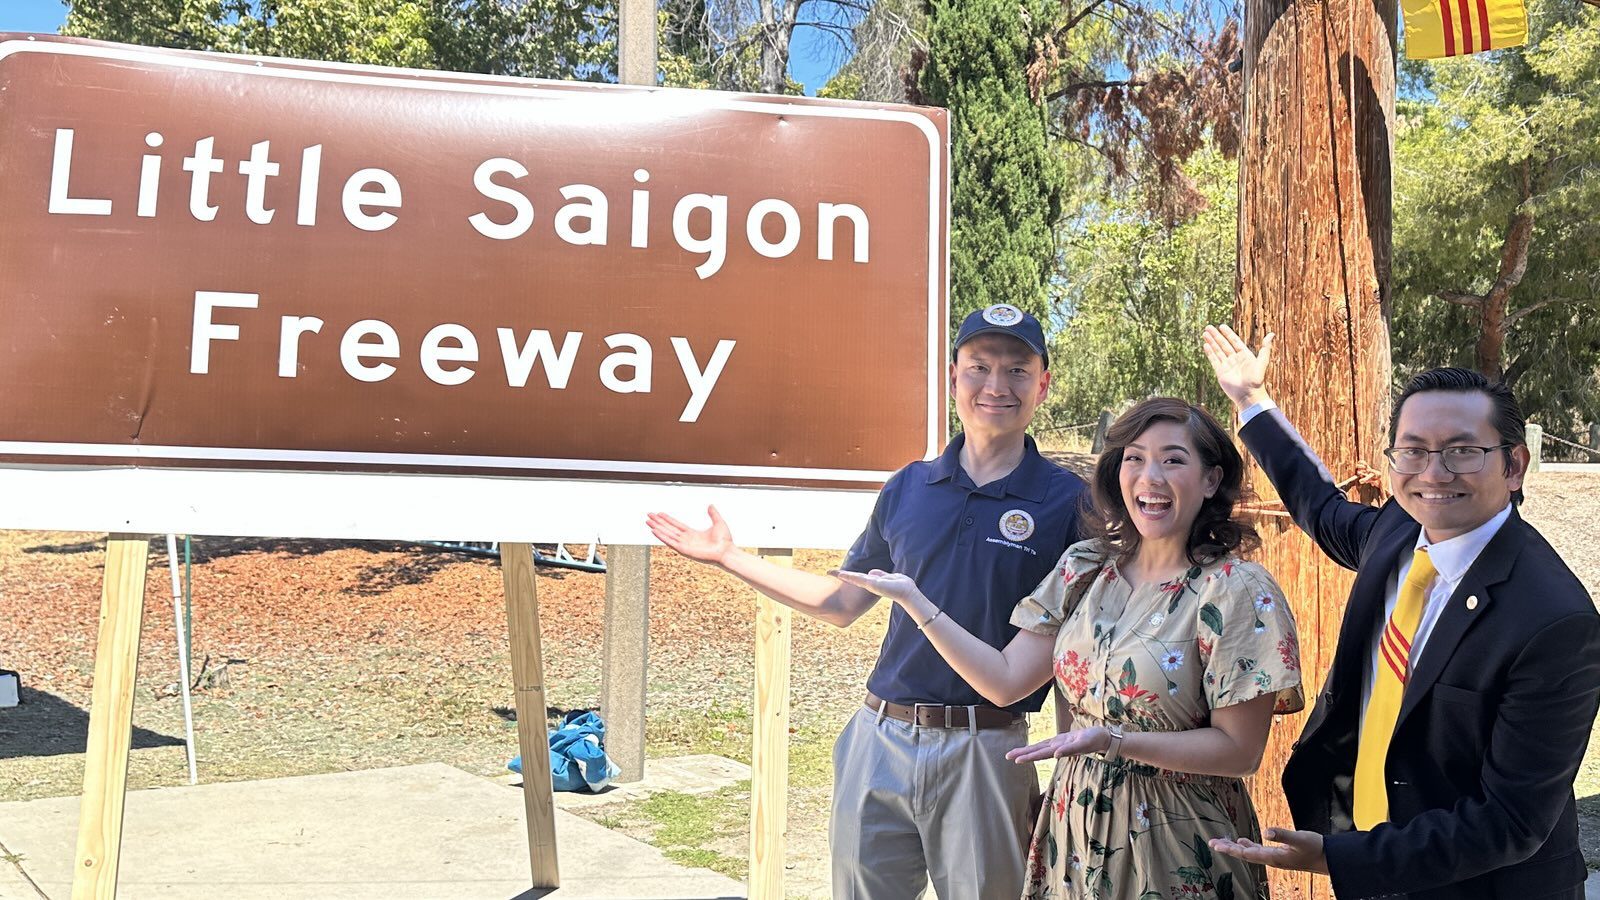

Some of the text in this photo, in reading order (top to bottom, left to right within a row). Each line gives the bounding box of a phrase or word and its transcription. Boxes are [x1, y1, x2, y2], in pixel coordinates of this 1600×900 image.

[48, 129, 869, 279] Little Saigon
[191, 291, 736, 422] Freeway
[985, 537, 1023, 550] Assemblyman
[1023, 545, 1031, 553] Tri
